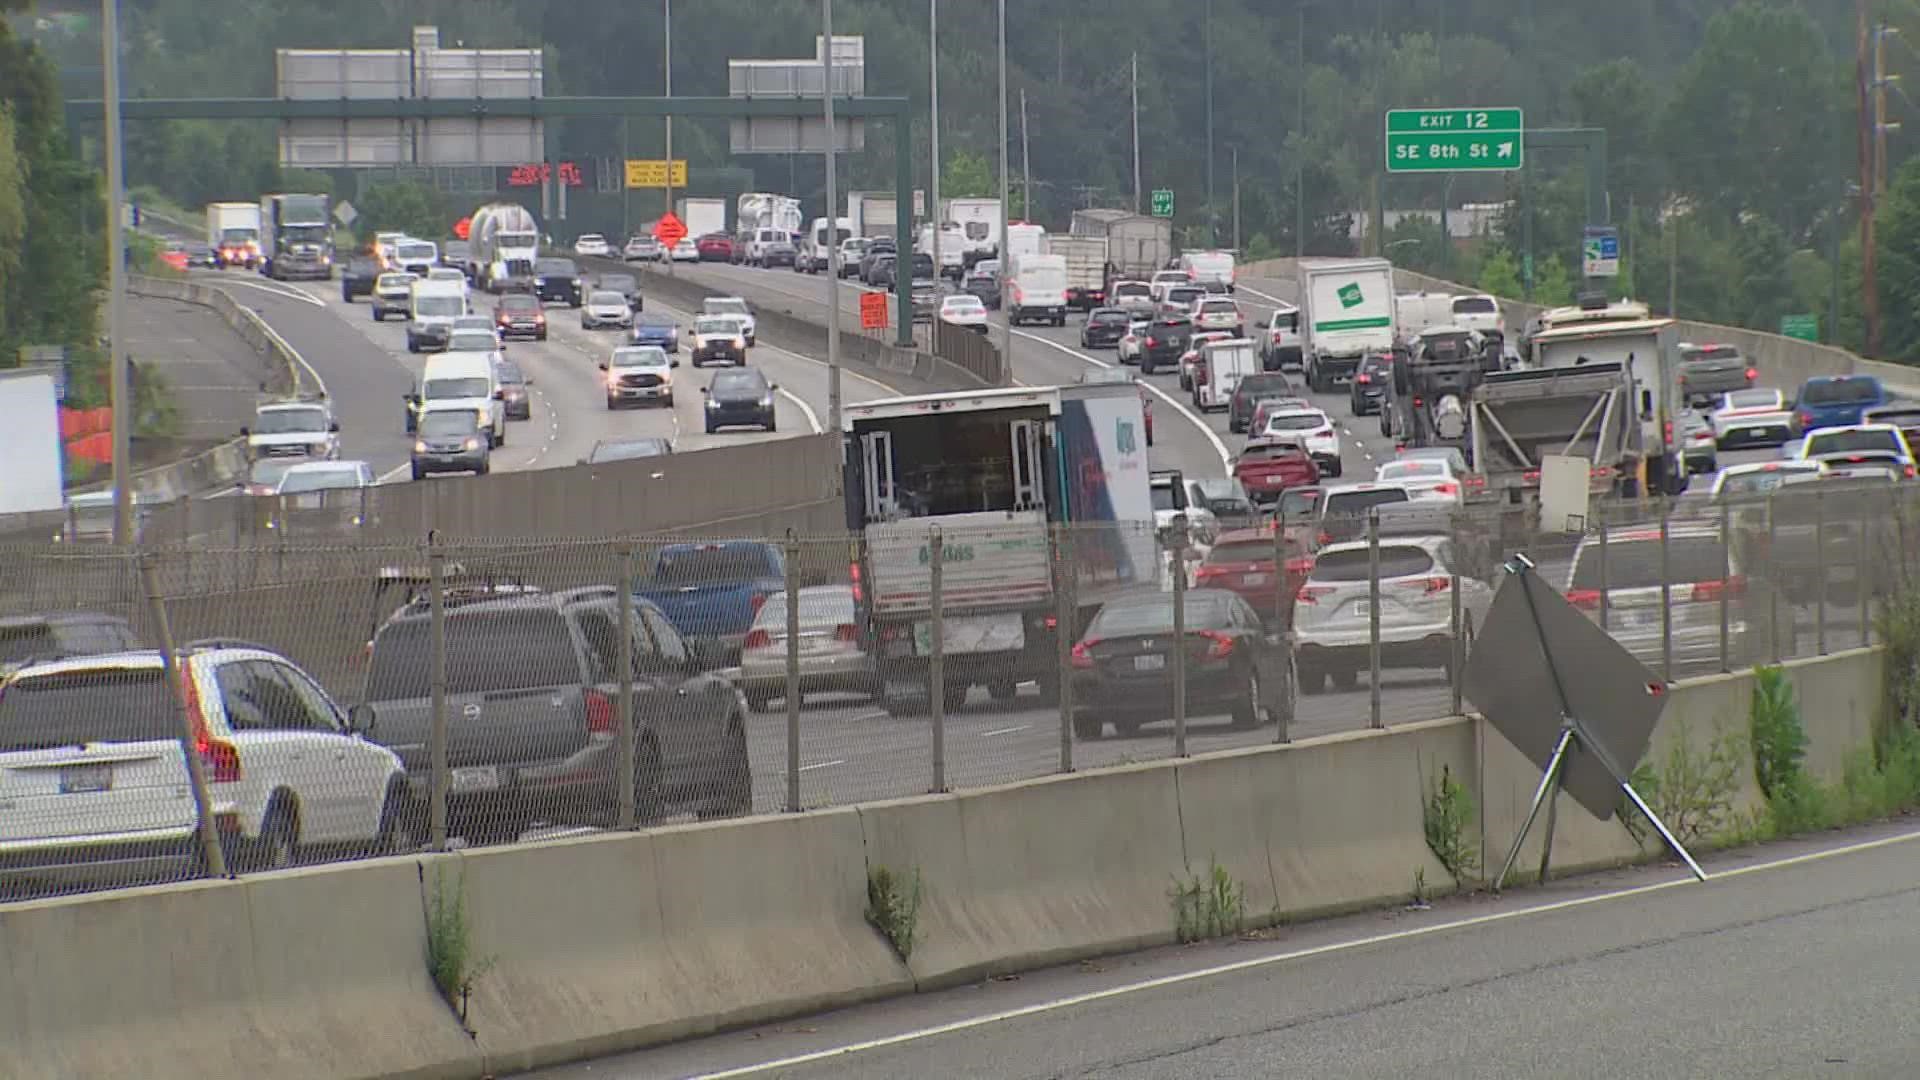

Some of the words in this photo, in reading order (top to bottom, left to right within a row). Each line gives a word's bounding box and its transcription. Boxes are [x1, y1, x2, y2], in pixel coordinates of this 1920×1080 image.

[1420, 115, 1453, 128] EXIT
[1465, 112, 1489, 128] 12
[1395, 144, 1420, 159] SE
[1429, 144, 1459, 159] 8th
[1469, 143, 1489, 158] St
